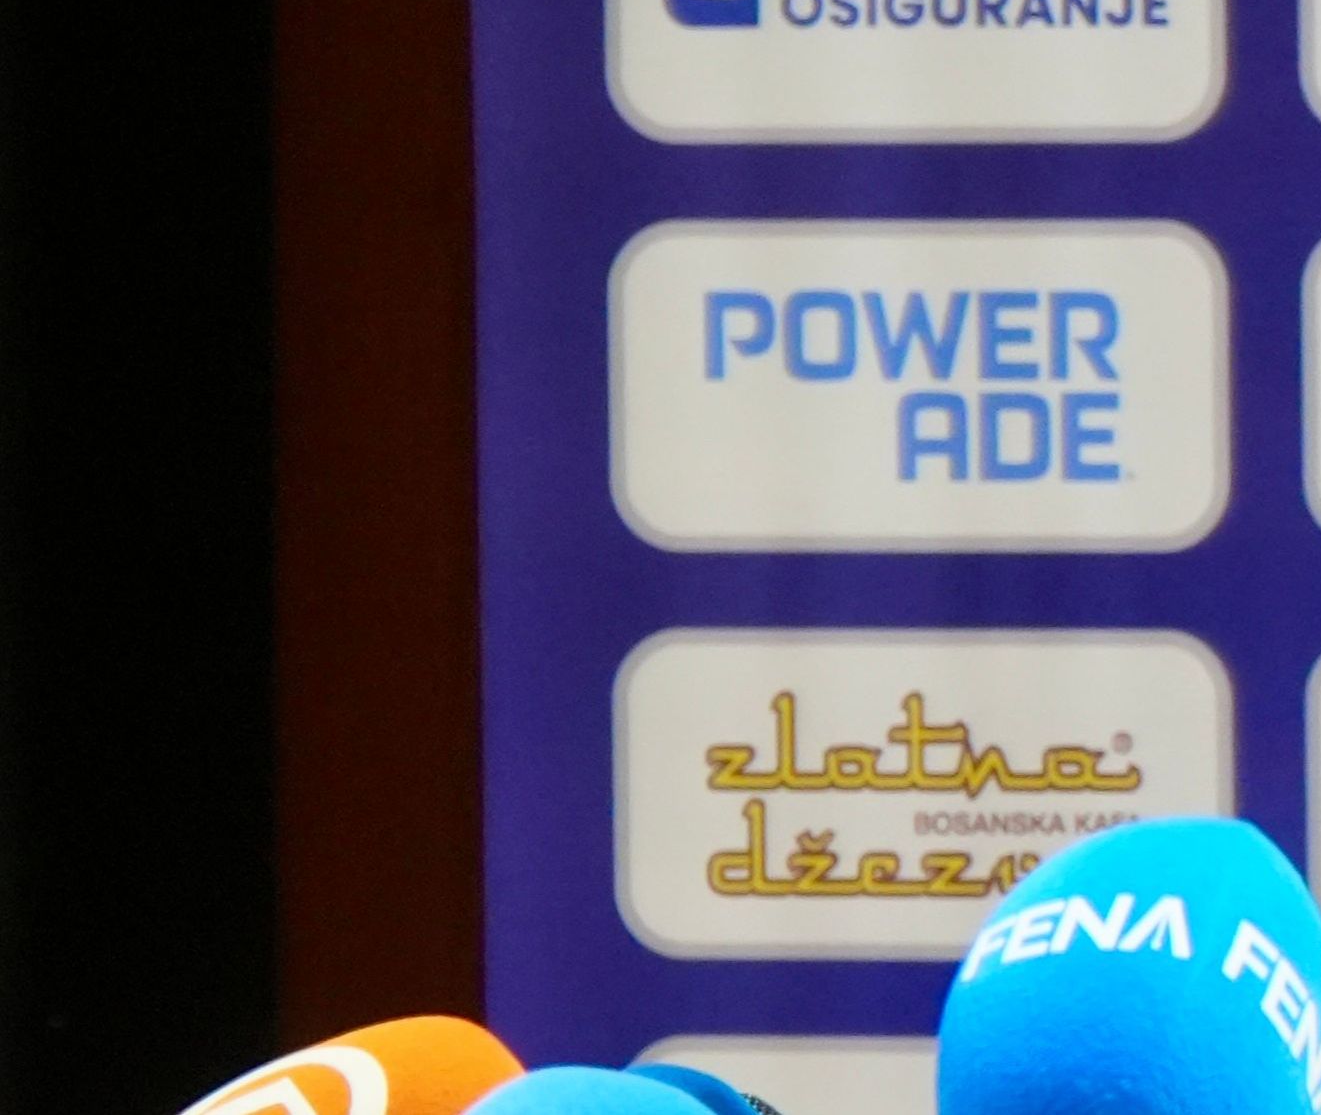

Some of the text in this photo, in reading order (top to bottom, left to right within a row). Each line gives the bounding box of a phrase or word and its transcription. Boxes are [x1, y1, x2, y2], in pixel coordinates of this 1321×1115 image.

[704, 291, 1122, 381] POWER
[898, 392, 1122, 482] ADE
[914, 811, 1066, 835] BOSANSKA
[959, 891, 1193, 983] FENA
